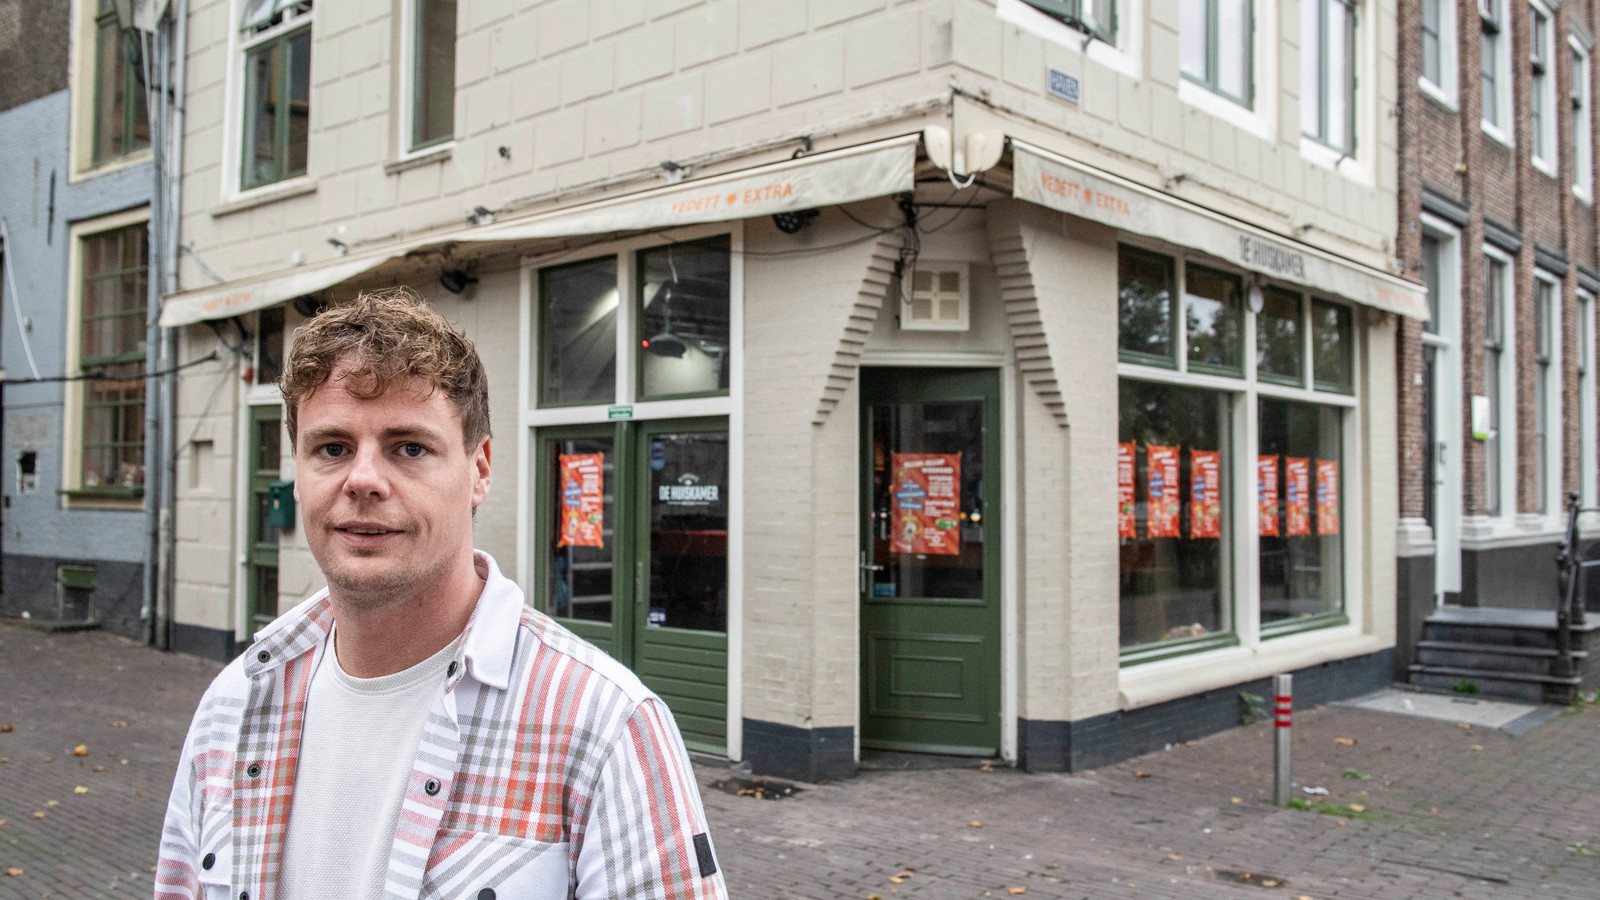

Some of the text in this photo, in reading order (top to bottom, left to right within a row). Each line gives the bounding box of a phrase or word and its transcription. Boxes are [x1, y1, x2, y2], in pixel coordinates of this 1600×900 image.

[743, 182, 793, 204] EXTRA
[1096, 192, 1130, 215] EXTRA
[659, 485, 719, 501] DE HUISKAMER
